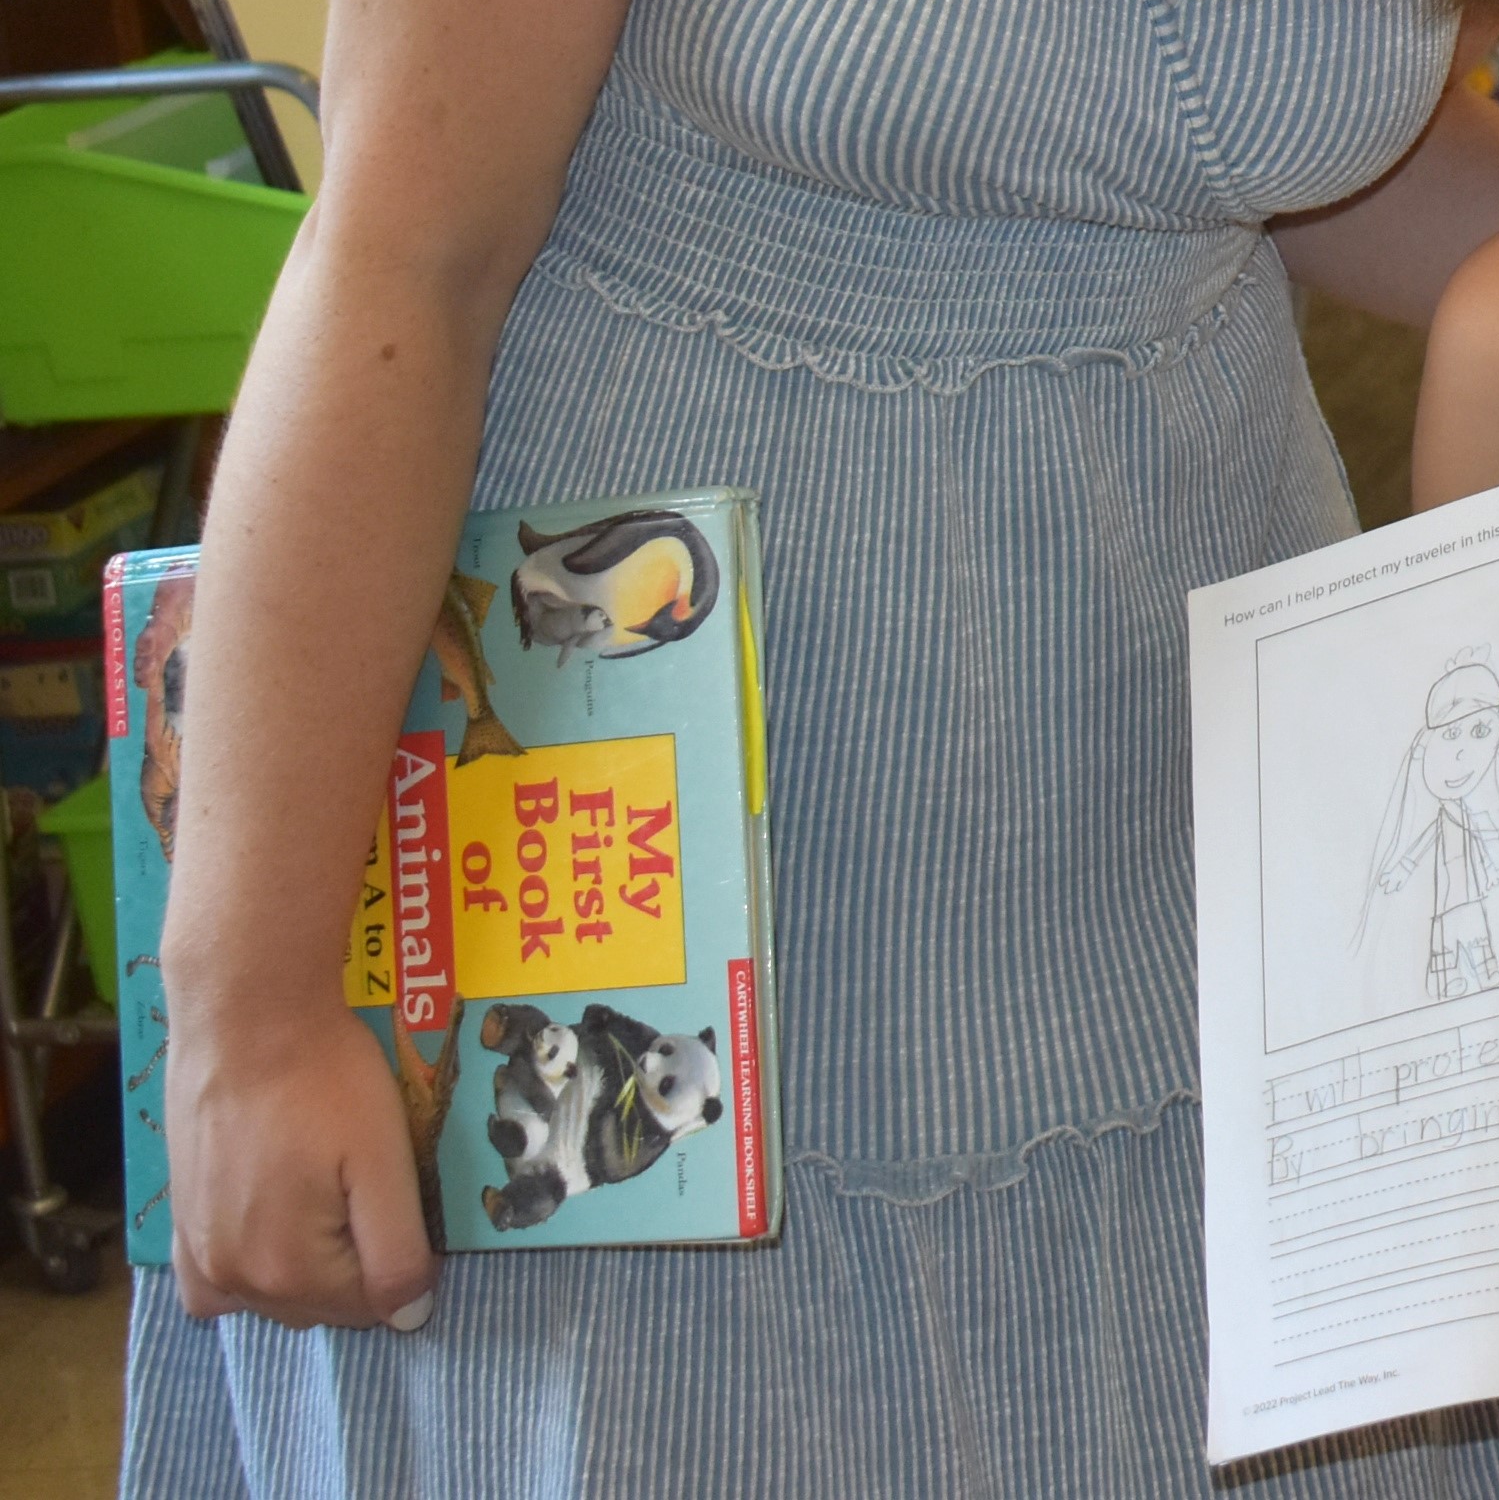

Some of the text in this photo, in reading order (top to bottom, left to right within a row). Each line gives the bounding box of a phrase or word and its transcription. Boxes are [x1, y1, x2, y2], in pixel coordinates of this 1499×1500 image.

[1224, 609, 1255, 627] How
[1259, 600, 1283, 616] can
[1295, 584, 1325, 604] help
[1328, 566, 1377, 596] protect
[1381, 561, 1402, 576] my
[1405, 541, 1457, 568] traveler
[1461, 534, 1474, 548] in
[584, 660, 594, 717] Penguins
[393, 747, 448, 1025] Animals
[461, 841, 508, 913] of
[514, 776, 564, 964] Book
[569, 787, 615, 944] First
[618, 800, 674, 919] My
[364, 882, 386, 910] A
[365, 923, 385, 957] to
[368, 970, 391, 995] Z
[736, 970, 757, 1220] CARTWHEEL LEARNING BOOKSHELF
[1306, 1046, 1362, 1113] will
[677, 1152, 688, 1196] Pandas
